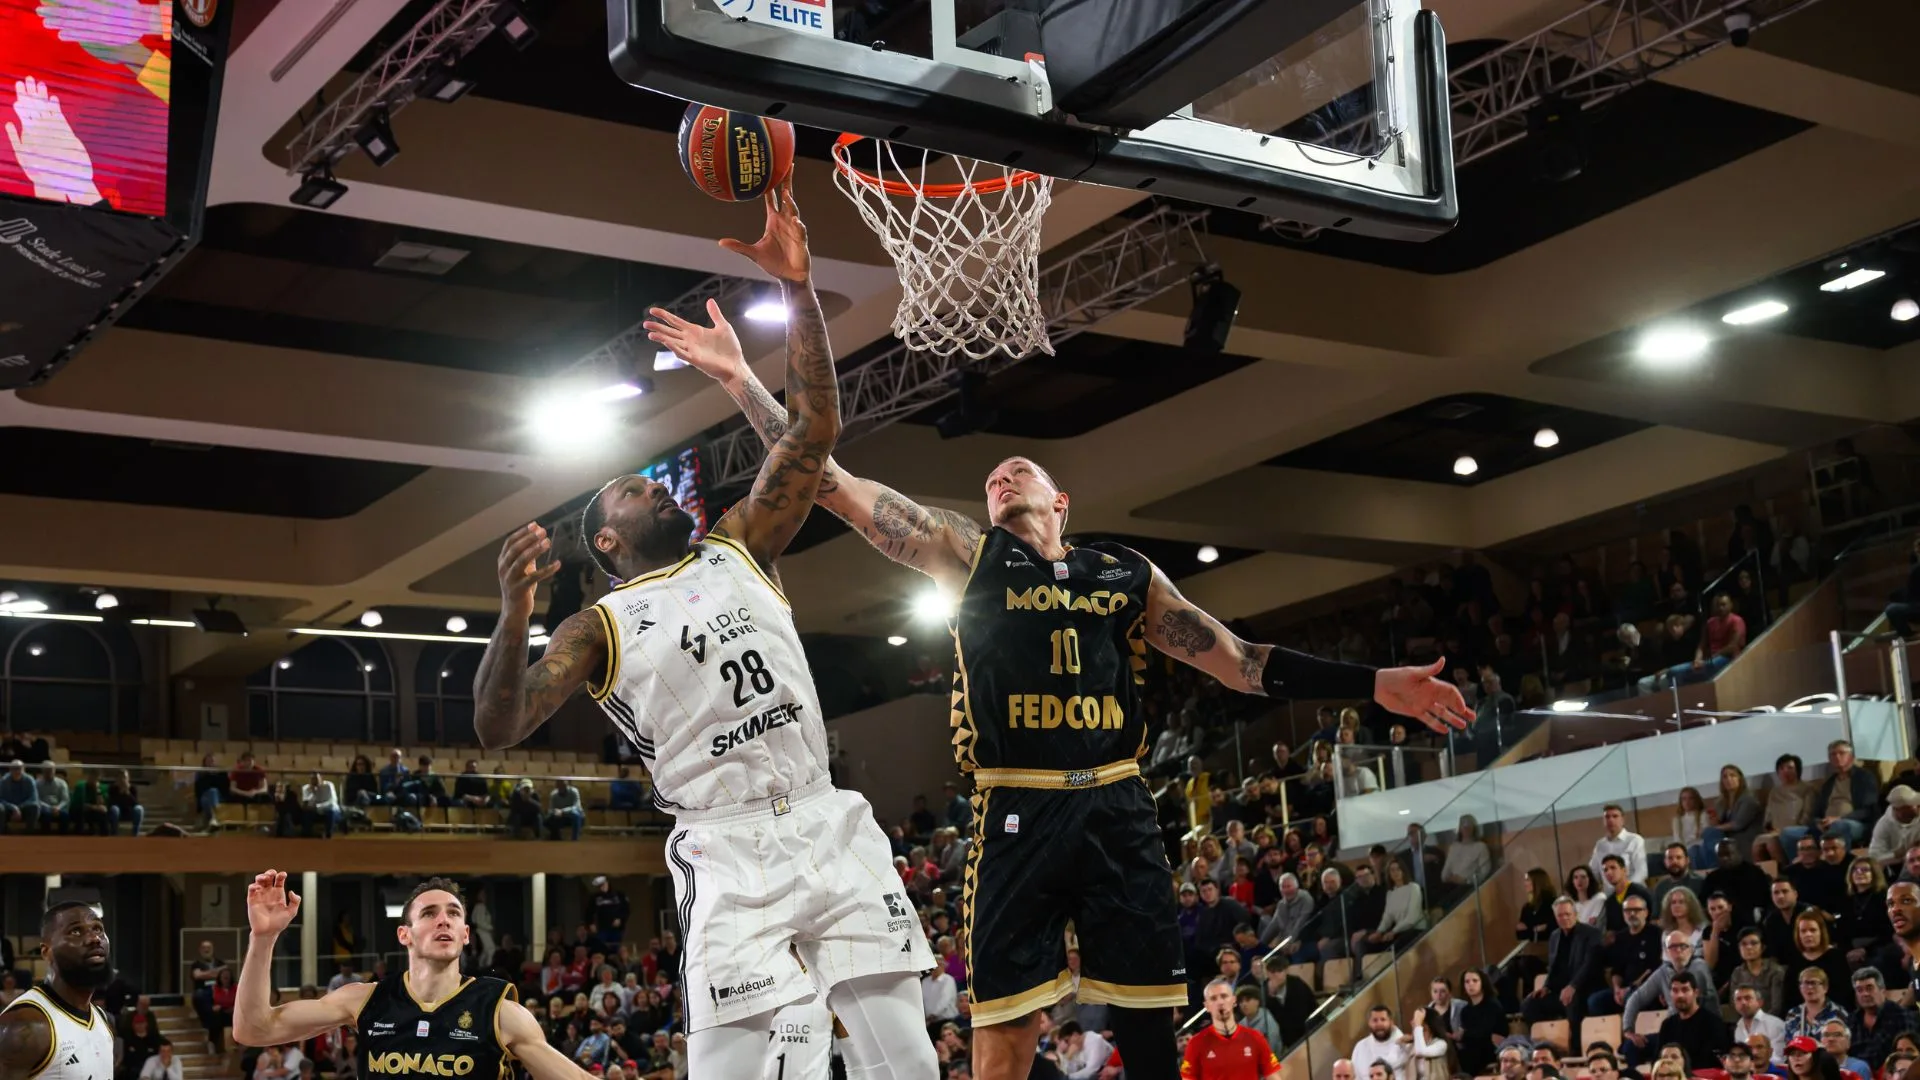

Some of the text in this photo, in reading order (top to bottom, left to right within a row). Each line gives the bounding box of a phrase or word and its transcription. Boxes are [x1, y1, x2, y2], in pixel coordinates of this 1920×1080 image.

[769, 0, 822, 29] ÉLITE
[735, 126, 753, 192] LEGACY
[708, 553, 726, 566] DC
[629, 603, 649, 616] CISCO
[1006, 584, 1129, 616] MONACO
[706, 607, 751, 633] LDLC
[719, 624, 758, 645] ASVEL
[1050, 628, 1081, 675] 10
[719, 649, 775, 708] 28
[1008, 694, 1124, 730] FEDCOM
[209, 886, 222, 907] J
[730, 975, 776, 997] Adéquat
[780, 1023, 811, 1035] LDLC
[780, 1035, 809, 1044] ASVEL
[368, 1050, 475, 1077] MONACO
